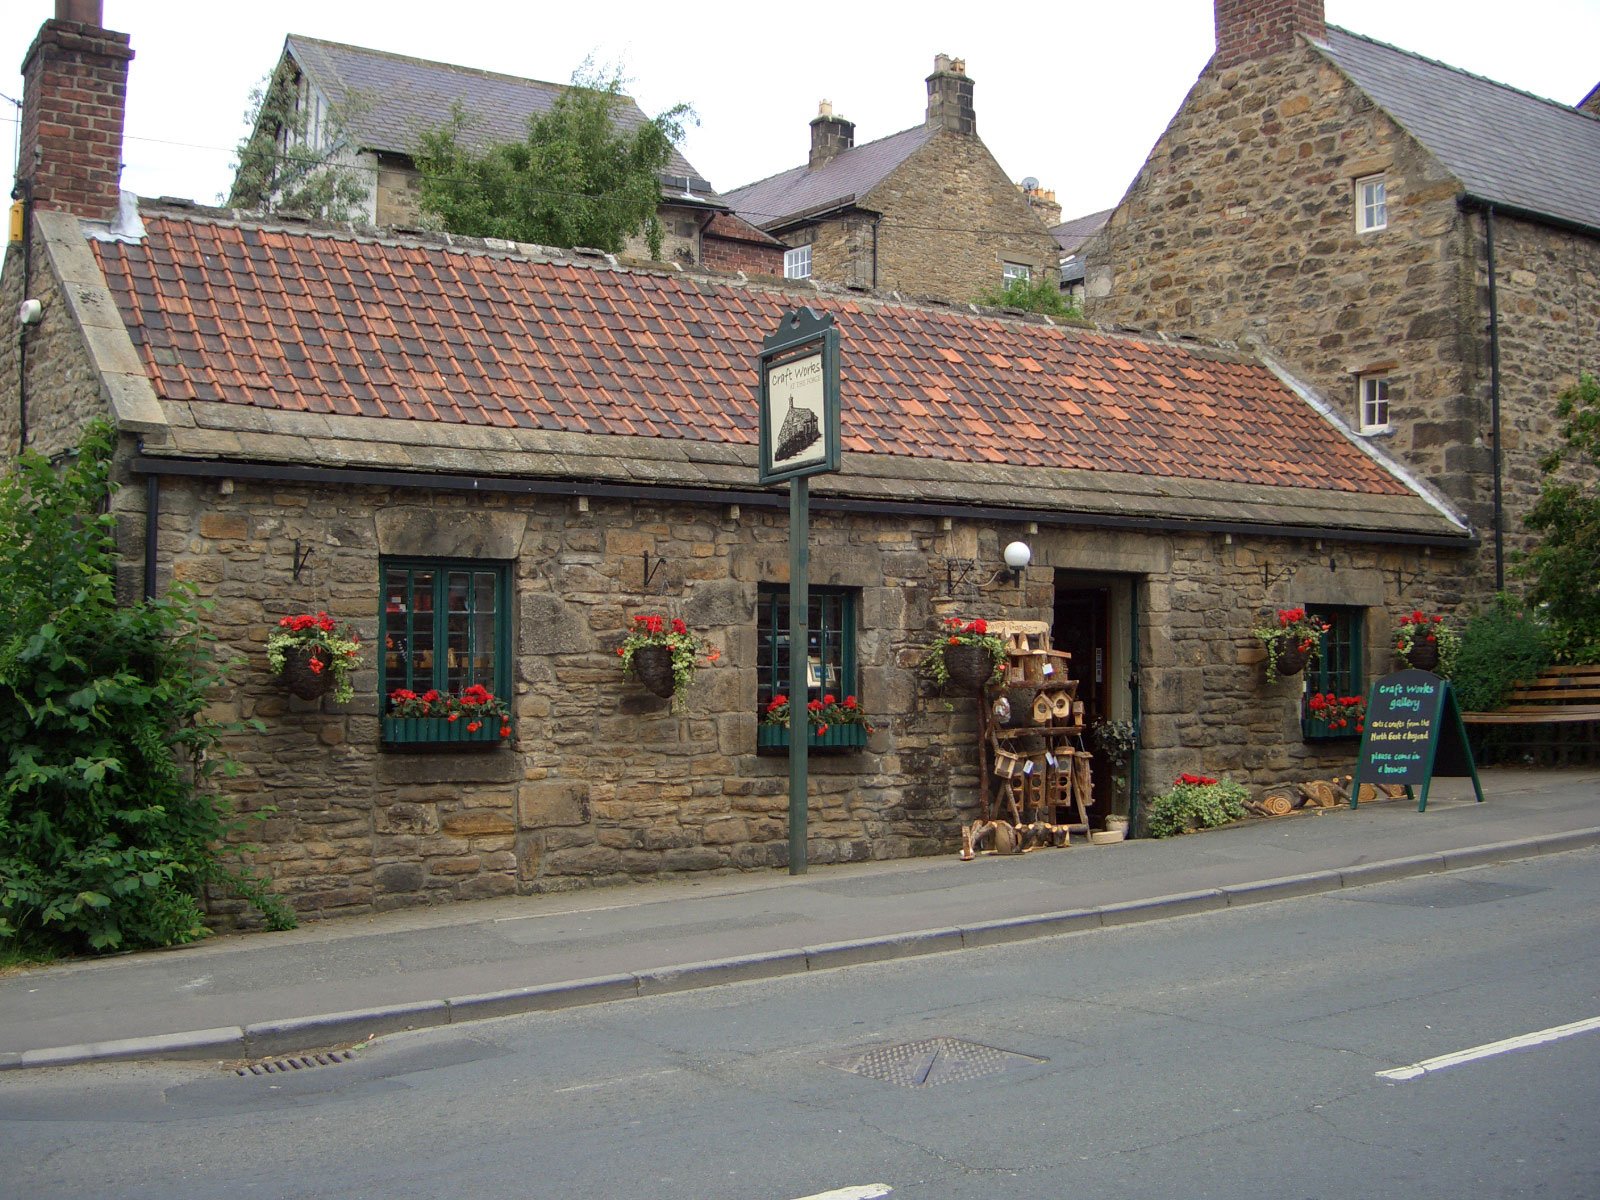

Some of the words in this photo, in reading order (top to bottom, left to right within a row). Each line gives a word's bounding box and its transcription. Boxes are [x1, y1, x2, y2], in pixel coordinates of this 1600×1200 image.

[772, 368, 792, 386] Craft
[795, 362, 820, 378] Works
[1389, 697, 1420, 711] gallery
[1406, 718, 1420, 729] from
[1420, 718, 1430, 727] the
[1370, 731, 1387, 742] North
[1388, 731, 1402, 740] East
[1371, 751, 1392, 764] please
[1384, 763, 1408, 774] browse
